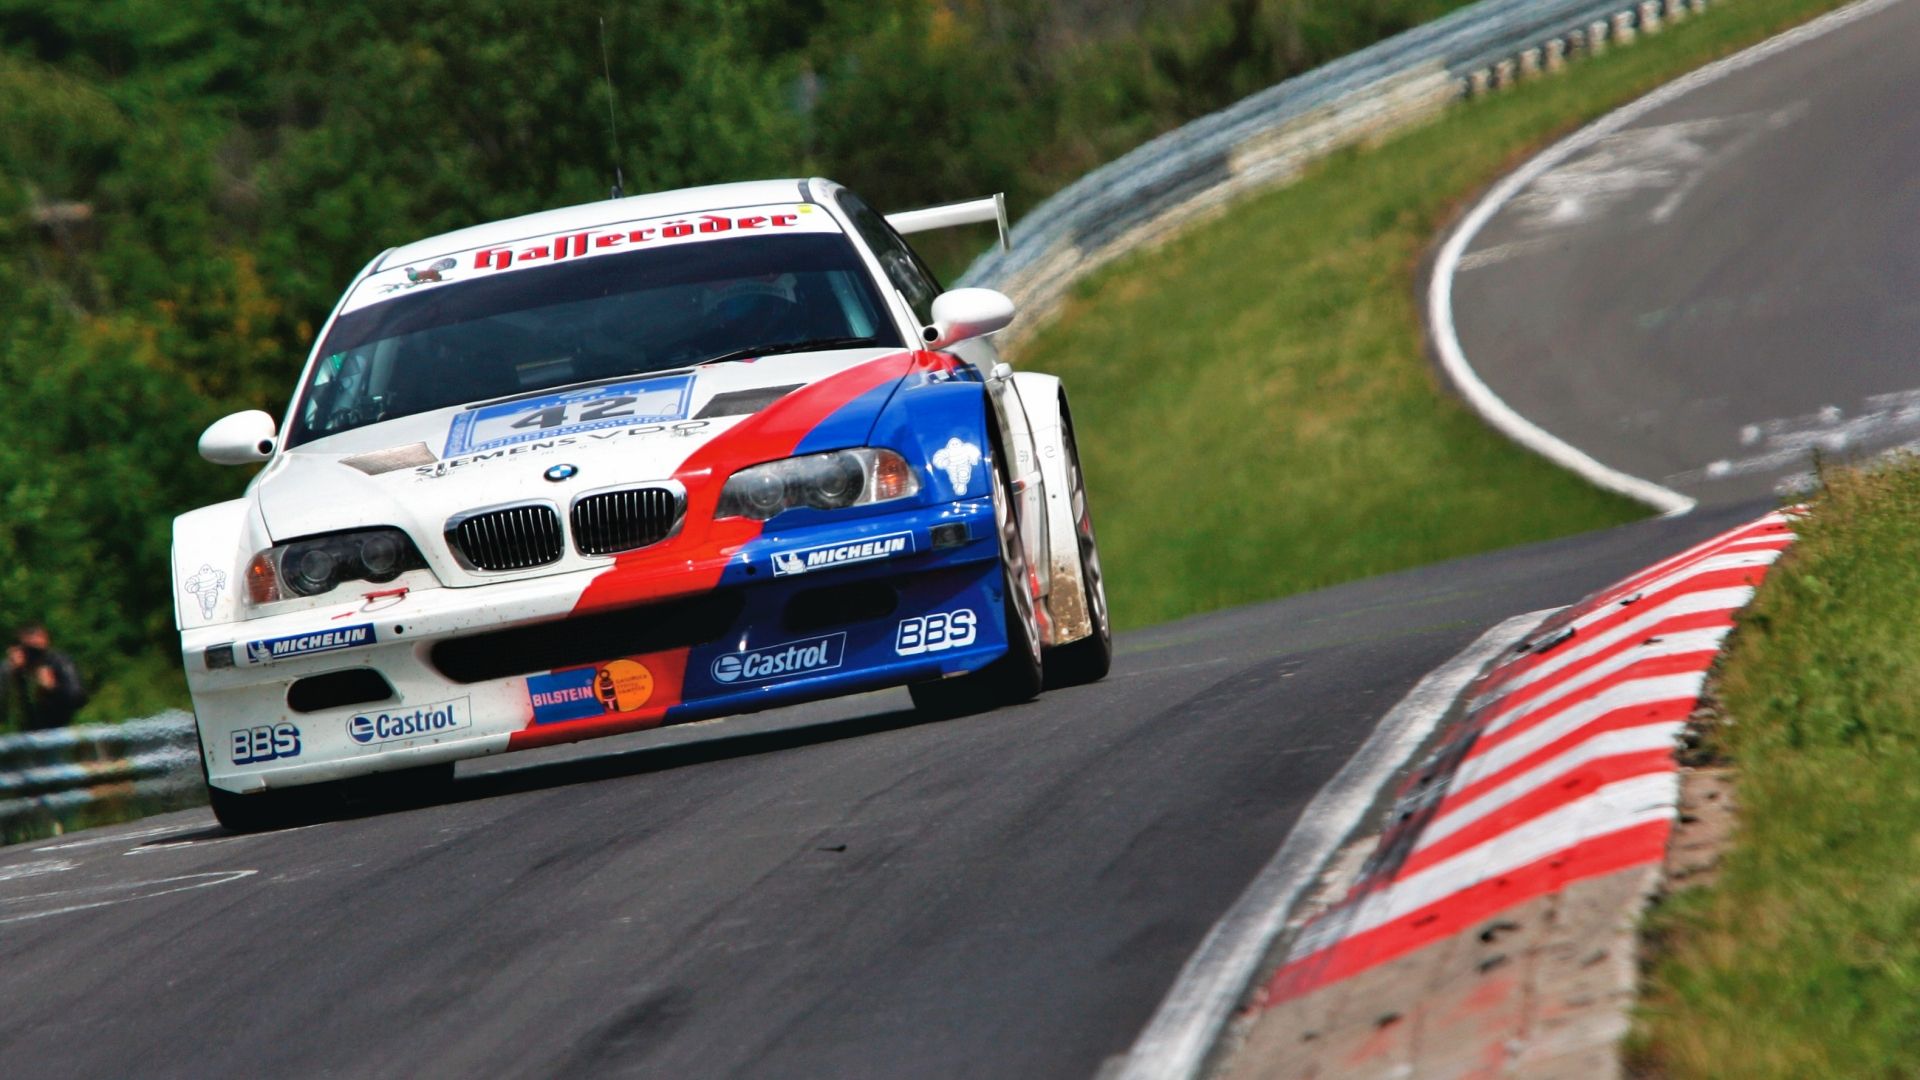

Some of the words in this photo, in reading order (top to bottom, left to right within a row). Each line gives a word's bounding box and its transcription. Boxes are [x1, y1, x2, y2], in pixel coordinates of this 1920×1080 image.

[510, 396, 637, 429] 42
[416, 437, 577, 473] SIEMENS
[589, 420, 711, 439] VDO
[807, 537, 905, 566] MICHELIN
[272, 628, 366, 655] MICHELIN
[896, 609, 977, 656] BBS
[743, 640, 828, 677] Castrol
[532, 686, 594, 707] BILSTEIN
[374, 705, 457, 739] Castrol
[231, 723, 301, 766] BBS
